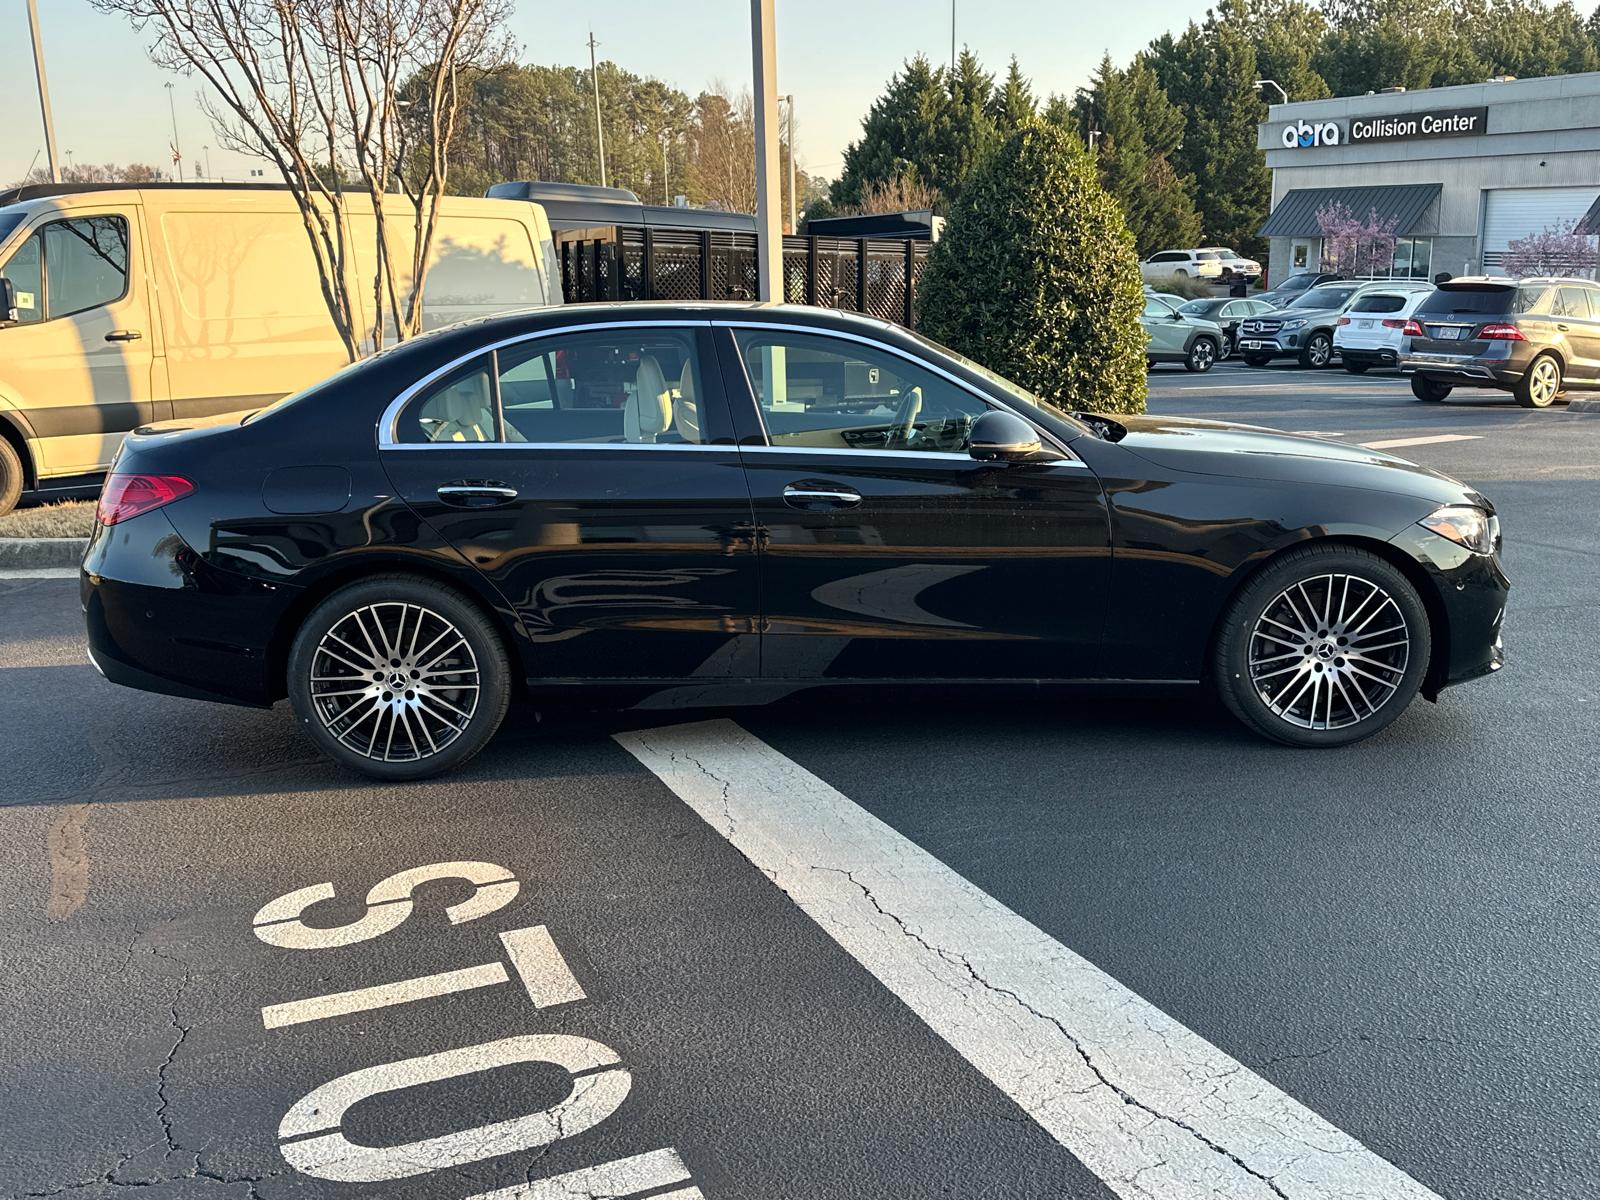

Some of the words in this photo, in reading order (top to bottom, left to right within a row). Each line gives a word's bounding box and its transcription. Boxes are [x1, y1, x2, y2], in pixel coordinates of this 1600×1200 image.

[1282, 120, 1340, 148] abra
[1352, 118, 1416, 139] Collision
[1421, 115, 1477, 135] Center
[1363, 561, 1419, 613] BRIDGESTONE
